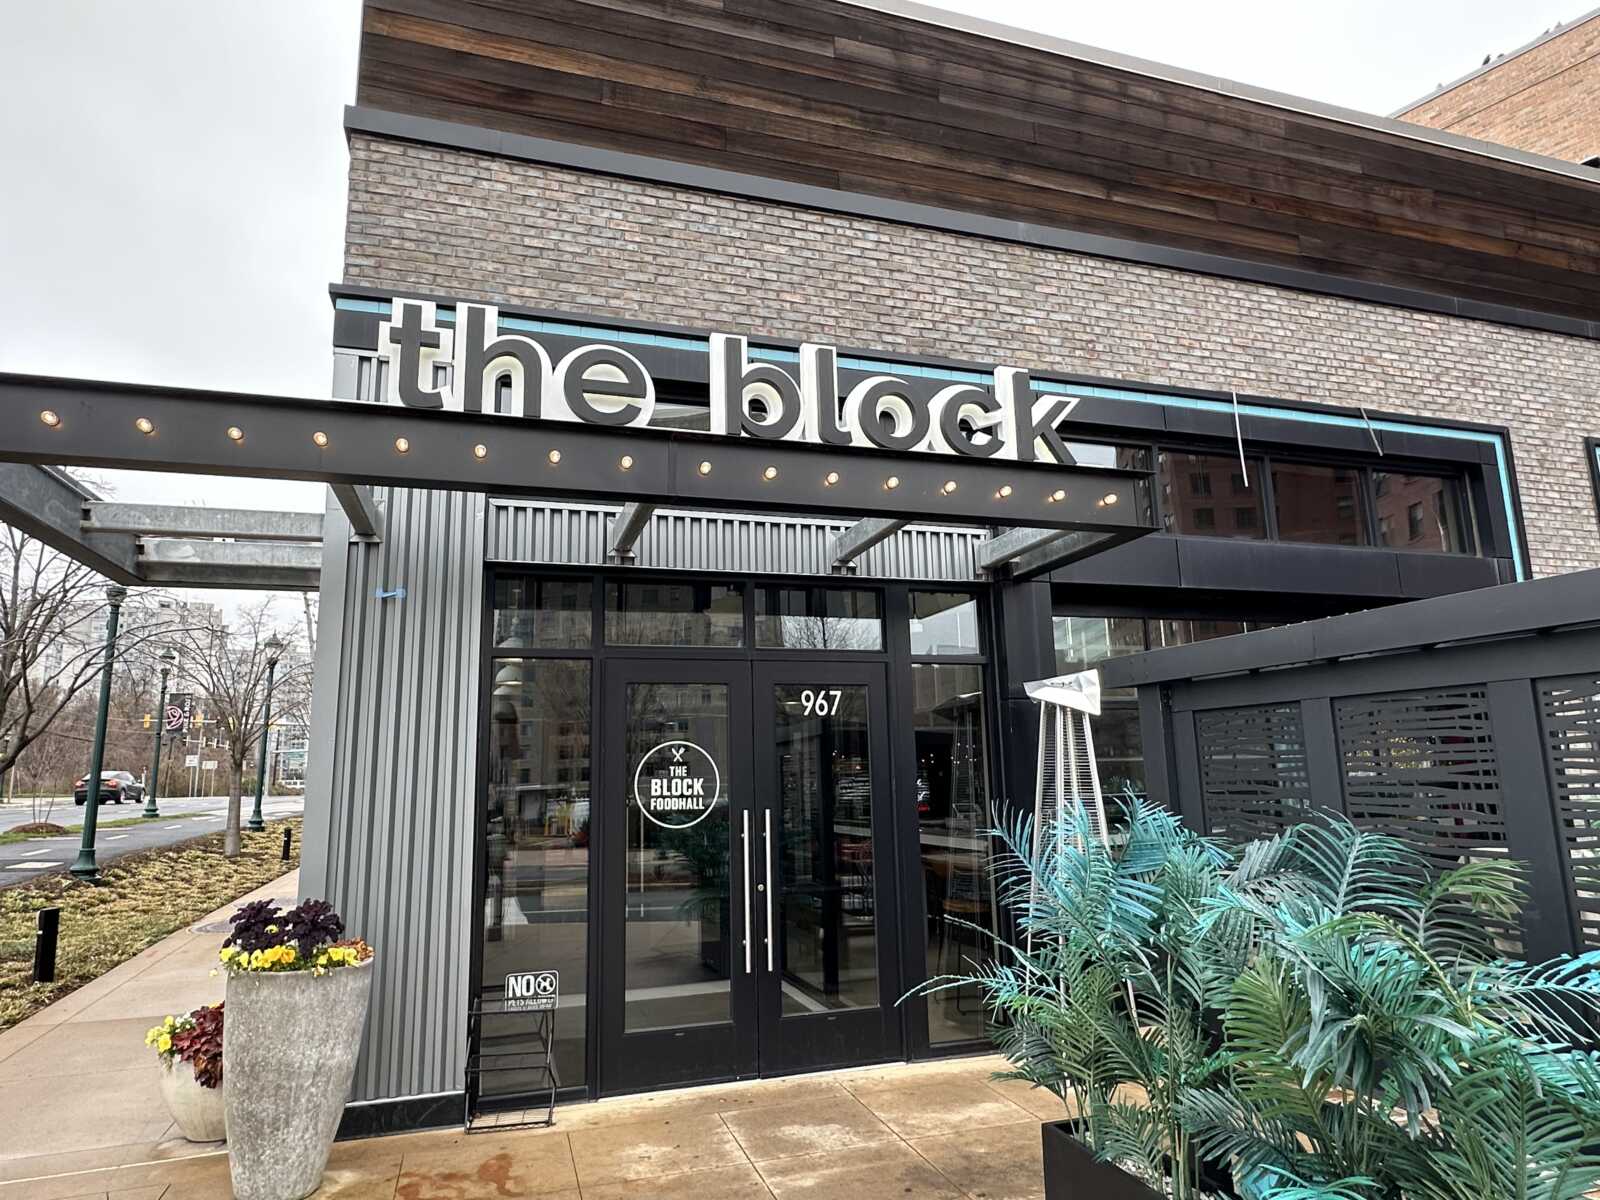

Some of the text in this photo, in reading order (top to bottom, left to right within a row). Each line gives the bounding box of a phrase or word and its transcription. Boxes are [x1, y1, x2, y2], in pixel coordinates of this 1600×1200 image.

[379, 297, 1079, 465] the block
[800, 690, 842, 716] 967
[669, 765, 687, 777] THE
[650, 778, 704, 796] BLOCK
[650, 797, 704, 811] FOODHALL
[508, 975, 535, 997] NO
